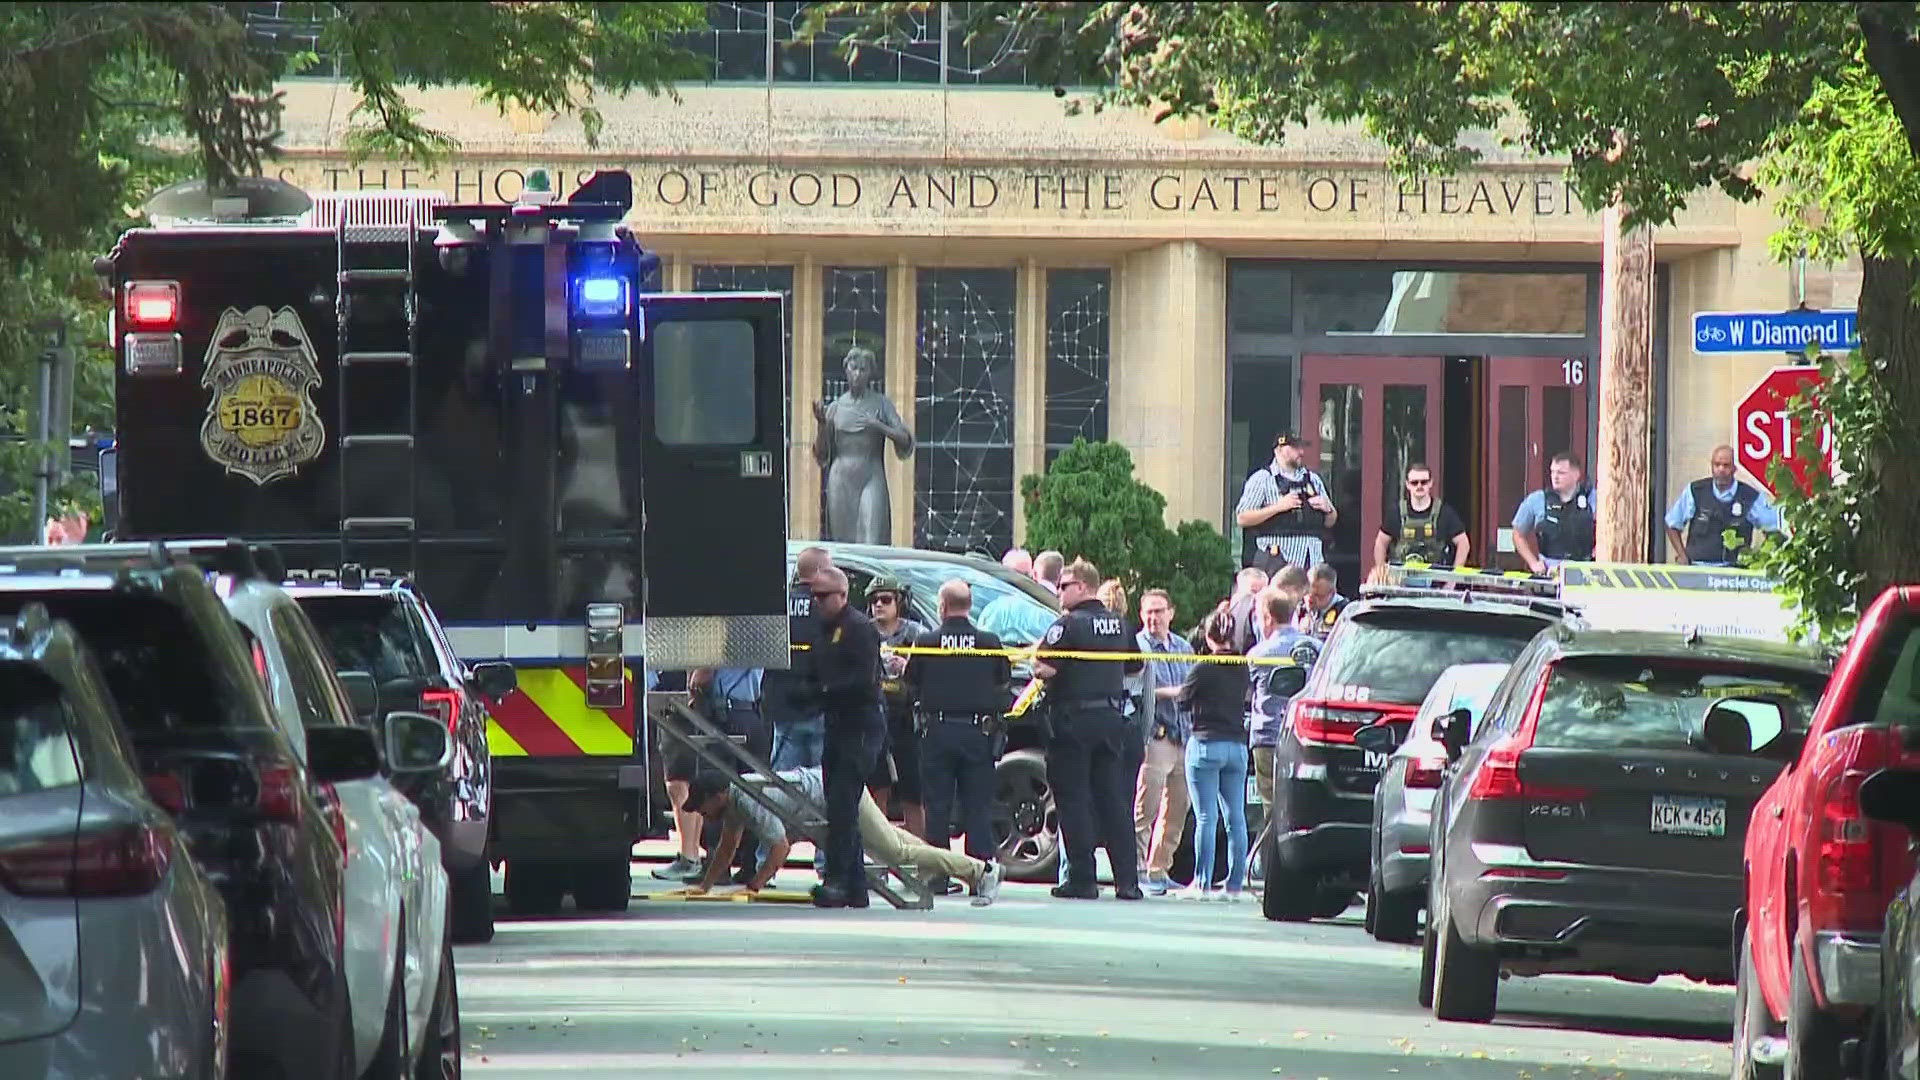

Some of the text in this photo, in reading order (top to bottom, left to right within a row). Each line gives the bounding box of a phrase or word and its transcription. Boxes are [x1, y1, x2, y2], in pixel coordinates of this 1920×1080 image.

[658, 171, 719, 205] OF
[749, 171, 861, 208] GOD
[887, 173, 999, 209] AND
[1025, 174, 1124, 210] THE
[1150, 175, 1280, 212] GATE
[1308, 177, 1369, 212] OF
[1729, 320, 1745, 345] W
[1751, 319, 1838, 345] Diamond
[223, 359, 301, 382] MINNEAPOLIS
[1562, 358, 1584, 385] 16
[231, 408, 292, 426] 1867
[1708, 574, 1748, 589] Special
[790, 598, 811, 617] LICE
[1093, 618, 1121, 635] POLICE
[941, 634, 976, 650] POLICE
[1621, 764, 1761, 783] VOLVO
